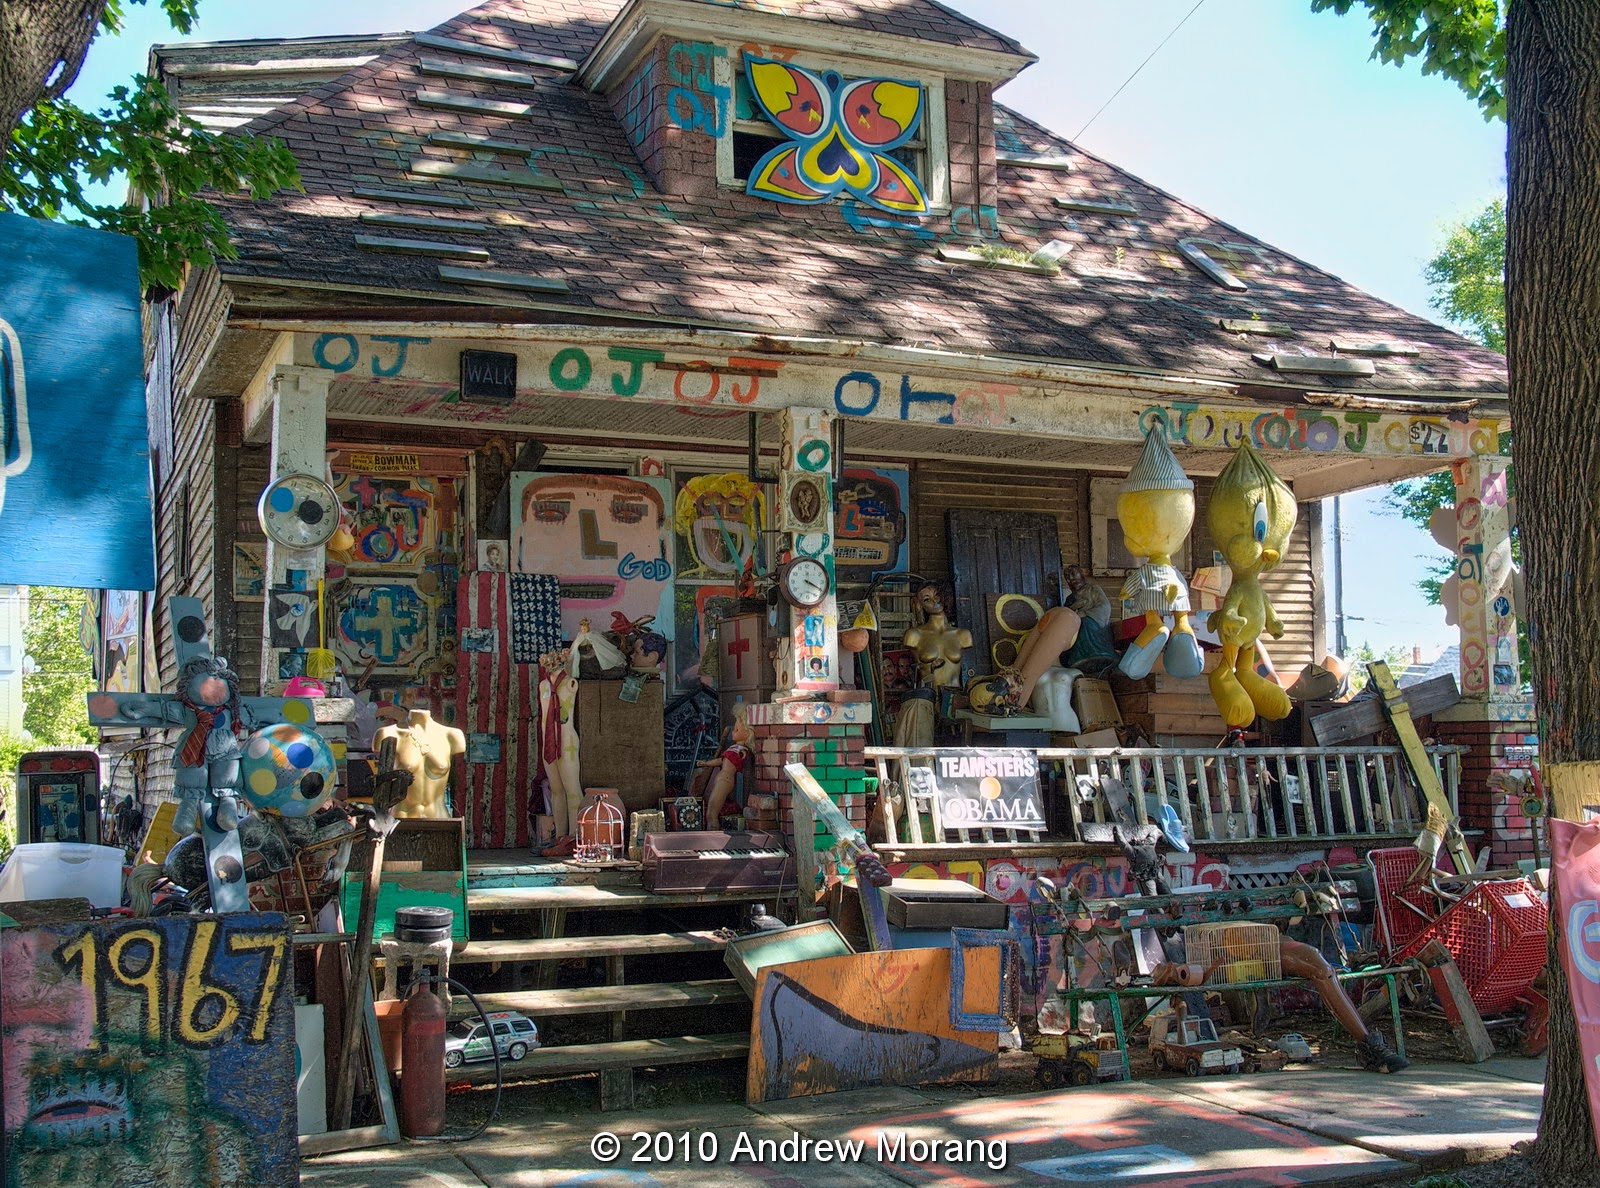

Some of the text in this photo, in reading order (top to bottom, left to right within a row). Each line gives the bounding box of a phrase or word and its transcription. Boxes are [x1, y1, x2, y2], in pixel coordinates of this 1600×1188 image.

[468, 364, 514, 386] WALK
[374, 455, 417, 466] BOWMAN
[939, 757, 1036, 778] TEAMSTERS
[944, 797, 1042, 822] OBAMA
[57, 920, 288, 1052] 1967
